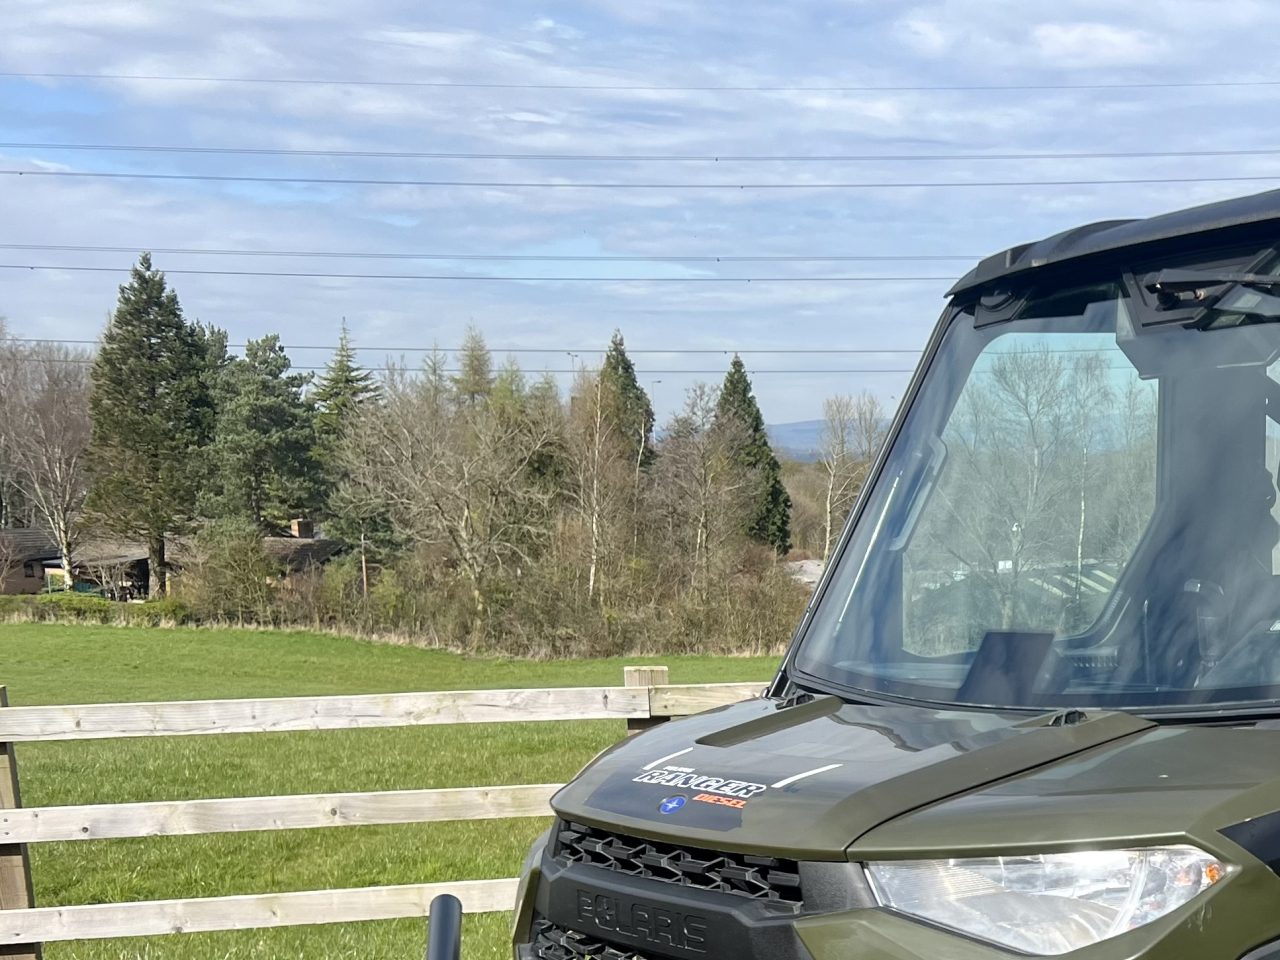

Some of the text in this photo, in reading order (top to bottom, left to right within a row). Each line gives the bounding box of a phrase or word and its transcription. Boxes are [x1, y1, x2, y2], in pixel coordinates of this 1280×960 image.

[632, 769, 767, 798] RANGER
[692, 793, 747, 809] DIESEL
[577, 889, 708, 953] POLARIS
